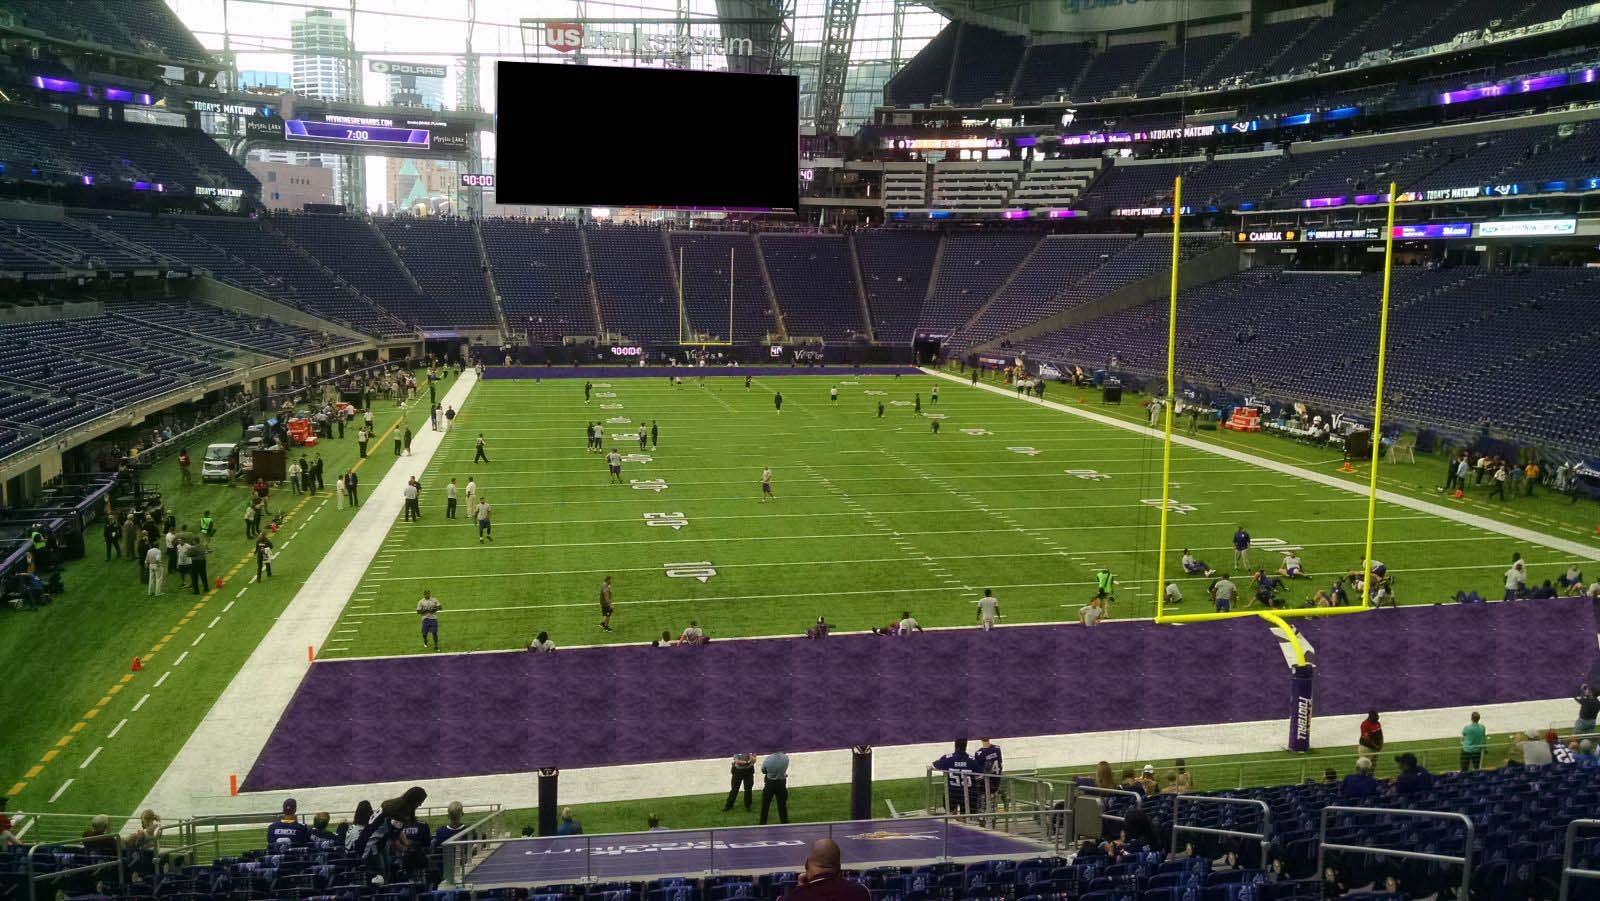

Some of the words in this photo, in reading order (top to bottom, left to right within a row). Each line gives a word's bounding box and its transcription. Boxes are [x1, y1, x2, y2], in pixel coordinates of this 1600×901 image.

[547, 28, 580, 46] us
[583, 23, 648, 50] bank
[392, 64, 445, 76] POLARIS
[193, 101, 220, 112] TODAY'S
[223, 105, 256, 116] MATCHUP
[346, 130, 369, 140] 7:00
[1154, 129, 1181, 139] TODAY'S
[1184, 126, 1215, 138] MATCHUP
[462, 175, 493, 186] 90:00
[800, 170, 813, 180] 40
[195, 186, 216, 195] TODAY'S
[217, 189, 243, 197] MATCHUP
[1426, 189, 1450, 199] TODAY'S
[1451, 187, 1480, 198] MATCHUP
[1250, 231, 1282, 241] CAMBRIA
[1297, 696, 1308, 740] FOOTBALL
